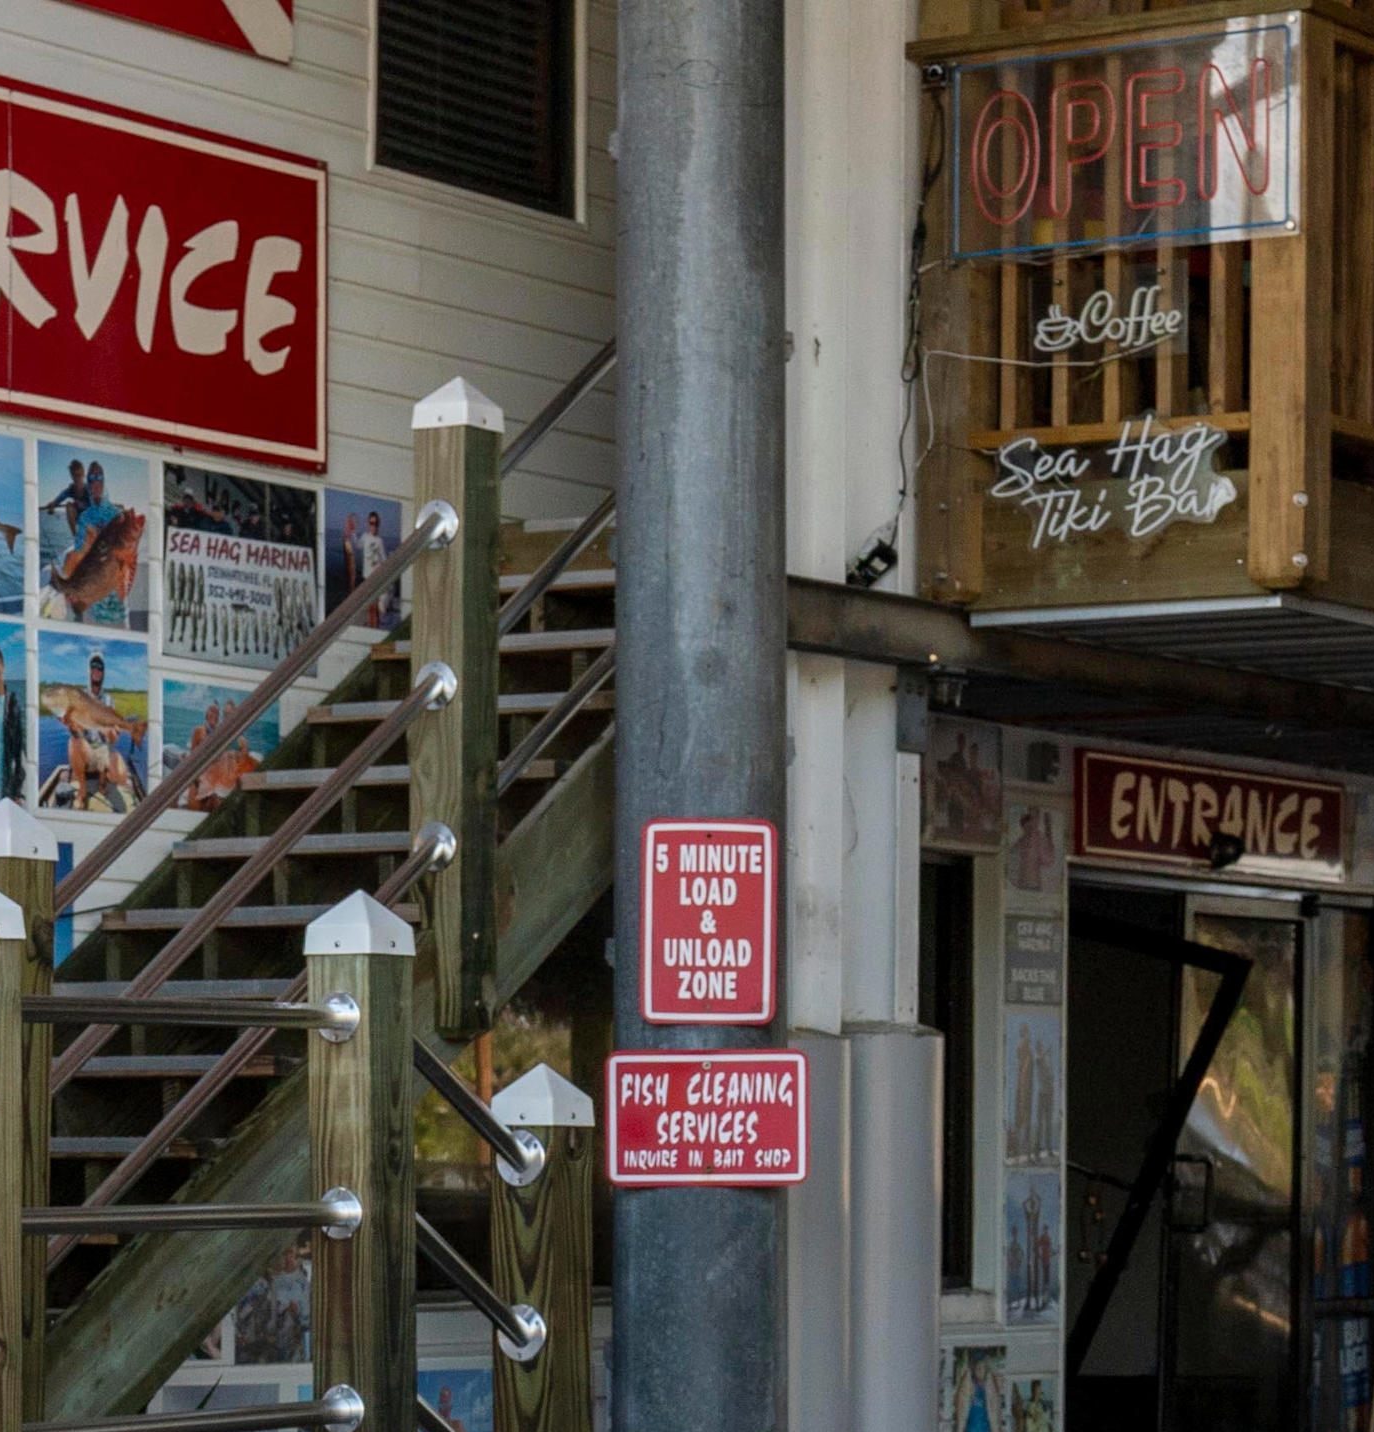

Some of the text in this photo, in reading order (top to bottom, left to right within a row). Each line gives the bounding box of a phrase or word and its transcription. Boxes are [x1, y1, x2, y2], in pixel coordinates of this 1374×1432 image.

[972, 57, 1272, 225] OPEN
[1080, 286, 1182, 347] Coffee
[991, 414, 1222, 497] Sea Hag
[1021, 474, 1233, 549] Tiki Bar
[170, 532, 312, 573] SEA HAG MARINA
[1111, 771, 1324, 859] ENTRANCE
[656, 843, 763, 875] 5 MINUTE
[679, 877, 738, 906] LOAD
[700, 909, 717, 934] &
[663, 938, 753, 968] UNLOAD
[678, 970, 738, 1000] ZONE
[621, 1072, 794, 1108] FISH CLEANING
[656, 1110, 759, 1145] SERVICES
[624, 1149, 792, 1170] INQUIRE IN BAIT SHOP
